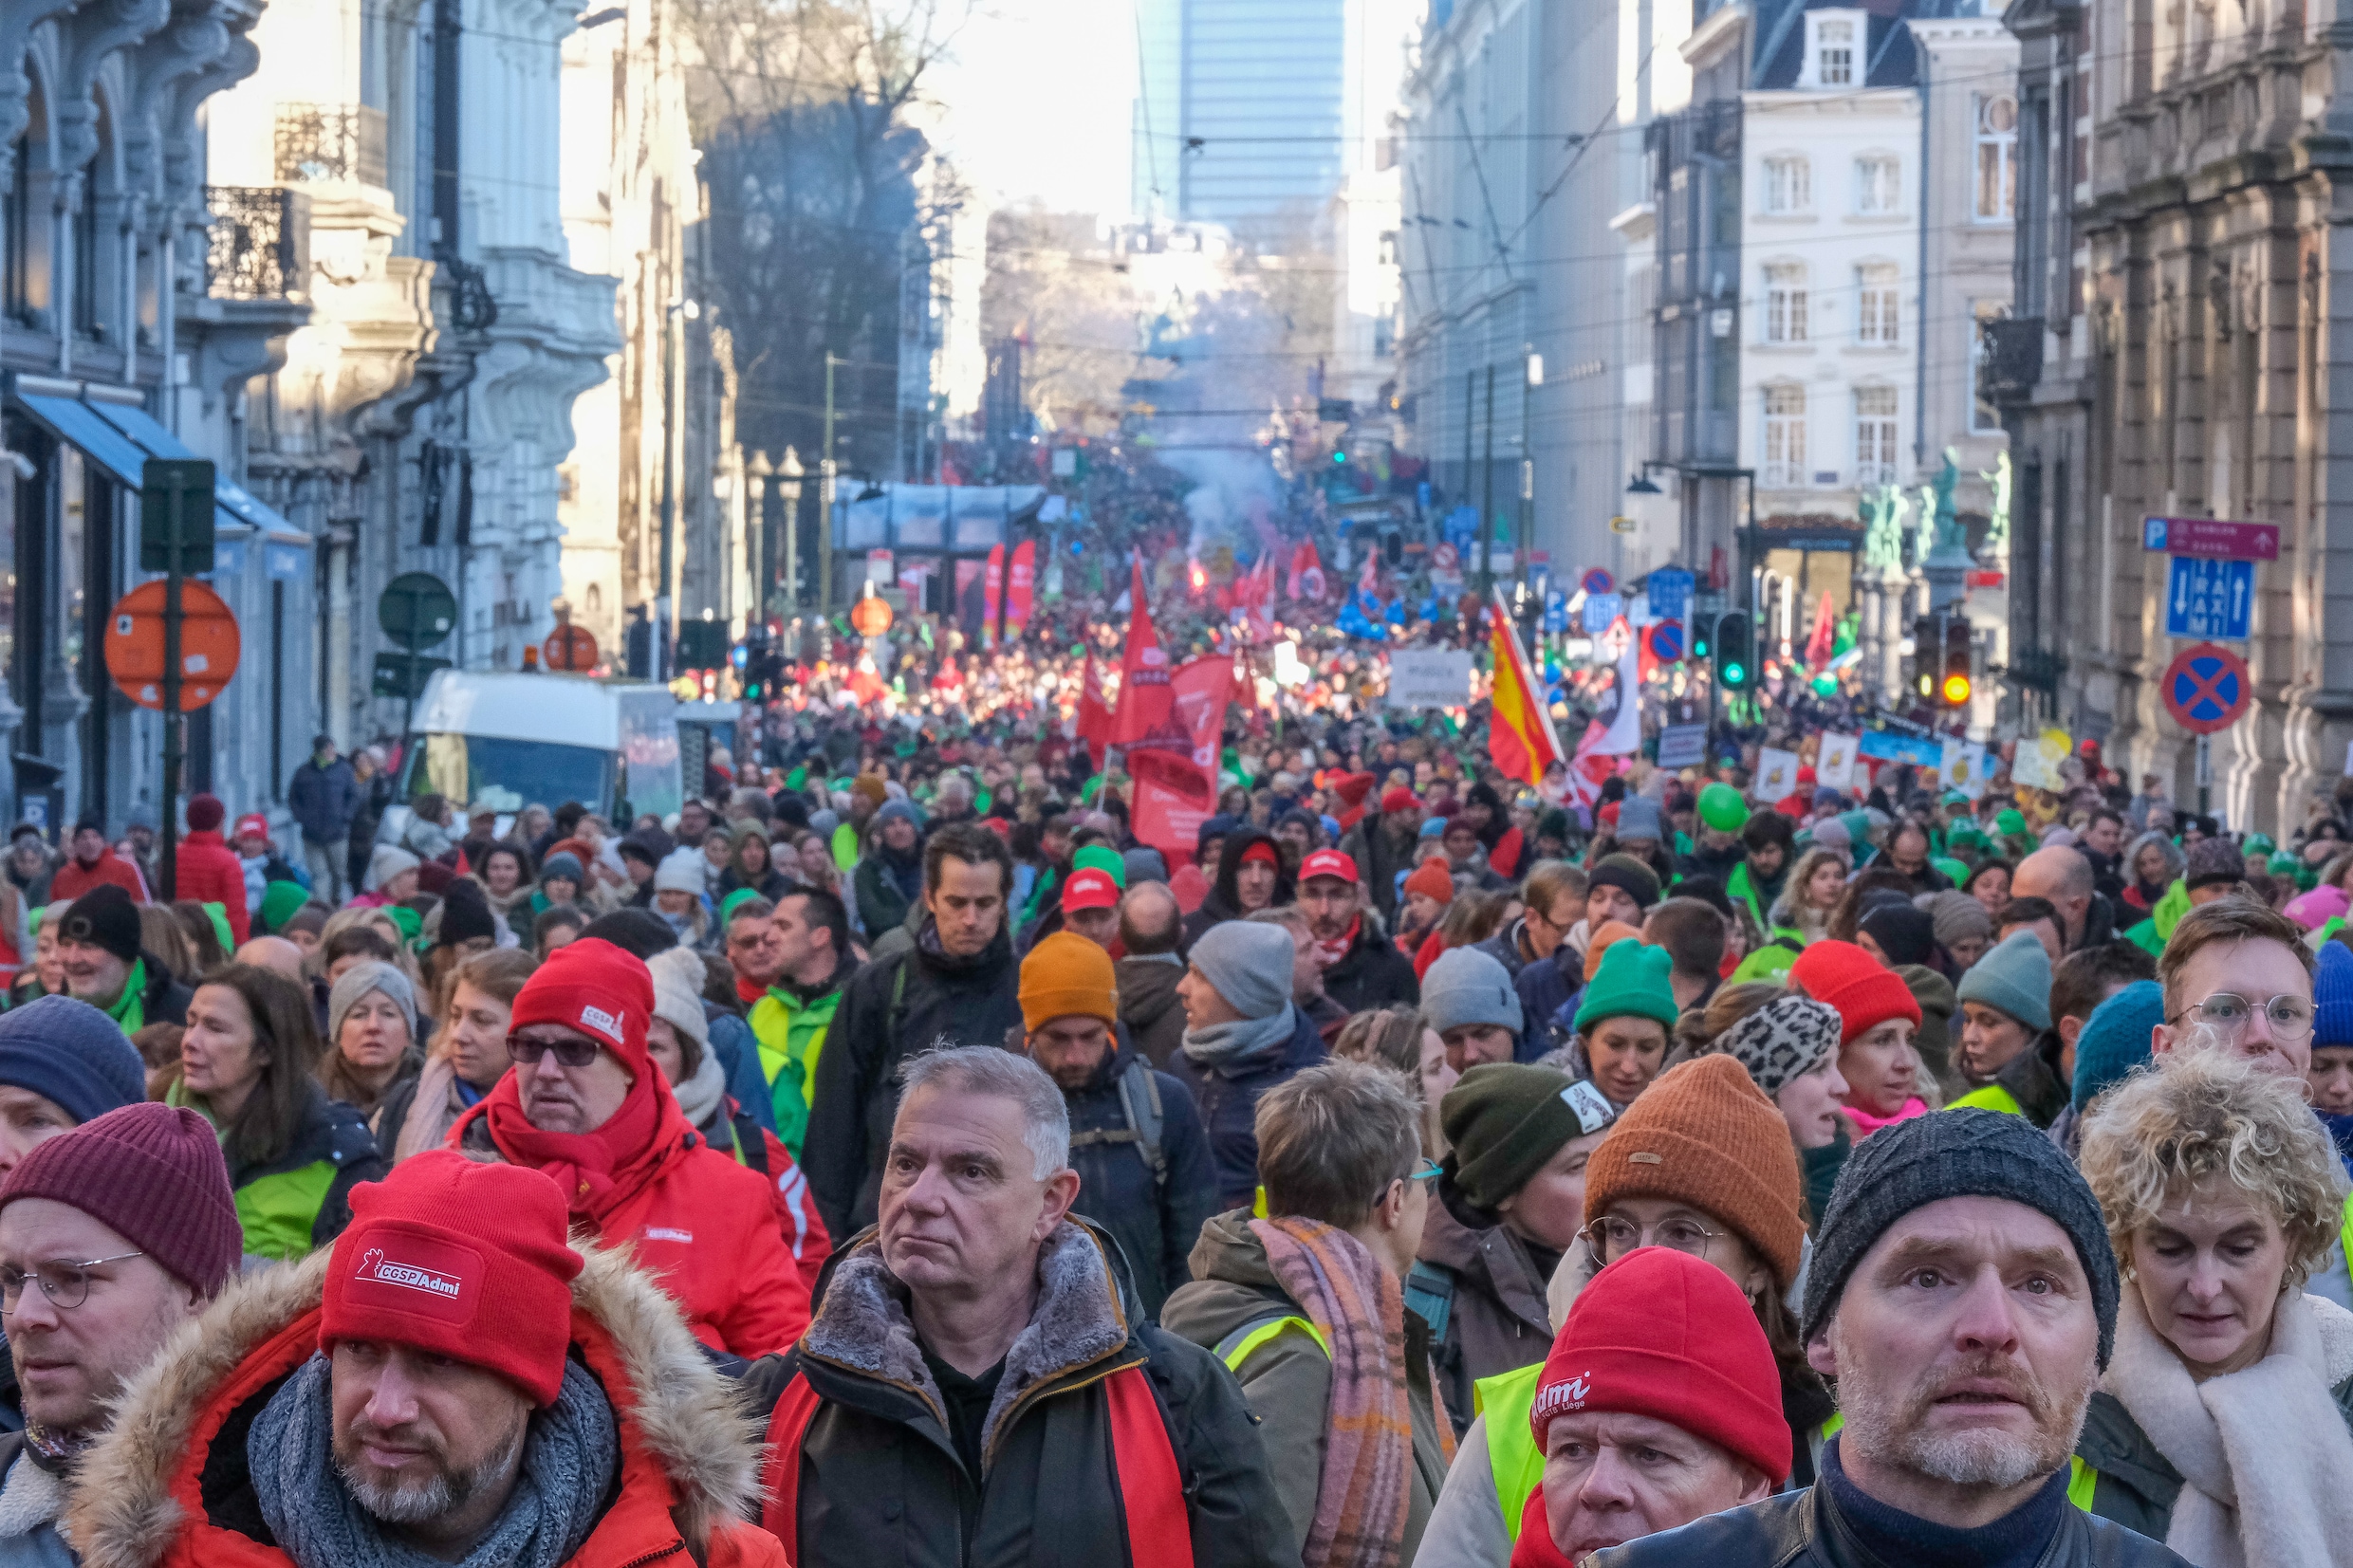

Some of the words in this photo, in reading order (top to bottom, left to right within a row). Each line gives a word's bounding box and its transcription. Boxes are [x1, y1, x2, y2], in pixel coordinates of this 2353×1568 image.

[2146, 519, 2165, 547] P
[381, 1265, 417, 1282] CGSP
[417, 1275, 460, 1296] Admi
[1562, 1400, 1585, 1411] Liège
